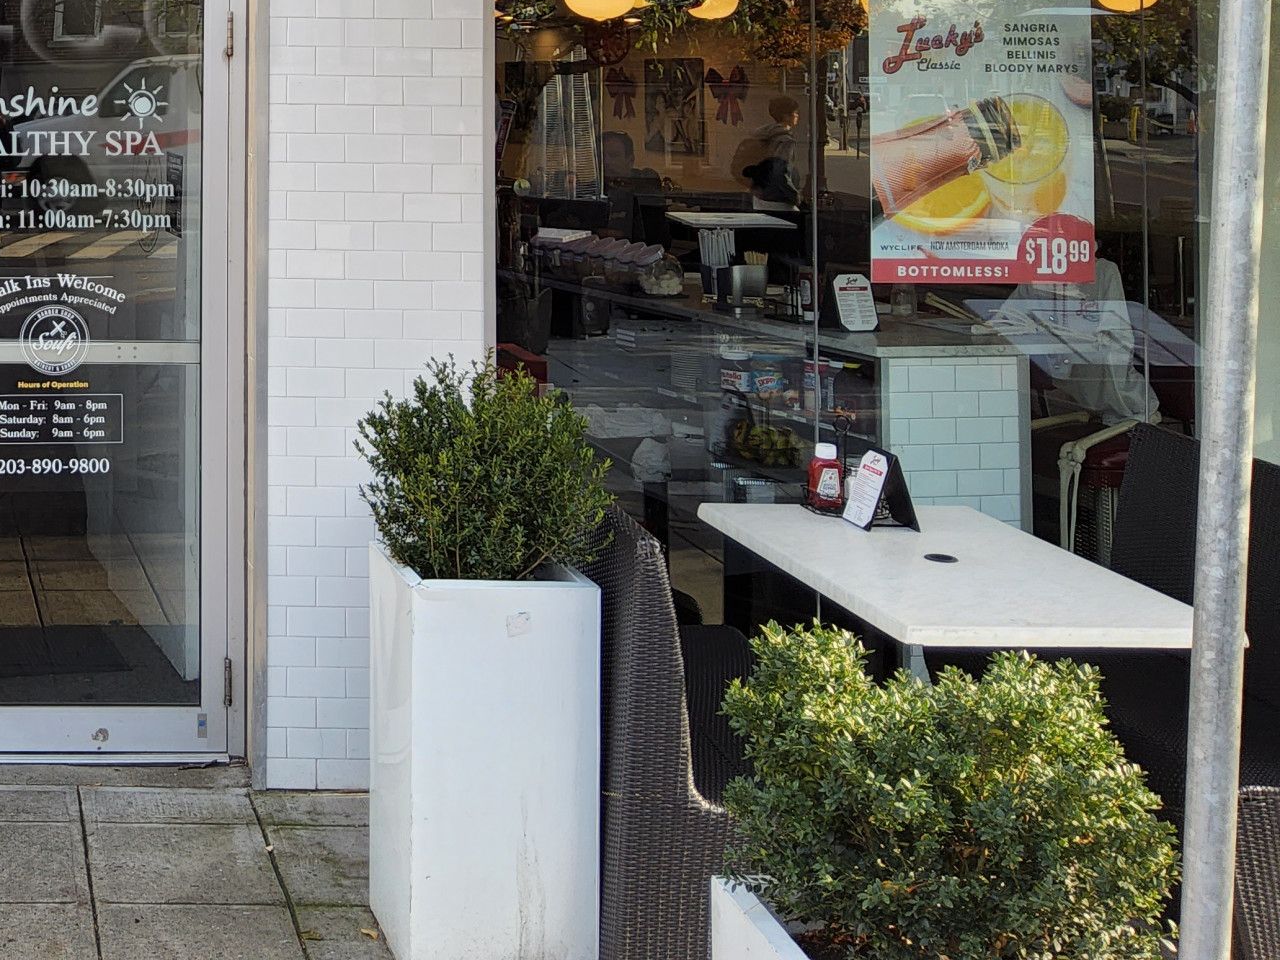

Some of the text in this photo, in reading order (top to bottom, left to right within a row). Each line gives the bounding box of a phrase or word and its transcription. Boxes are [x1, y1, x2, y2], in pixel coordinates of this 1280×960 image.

[1004, 23, 1058, 33] SANGRIA
[882, 14, 985, 75] Lucky's
[1002, 37, 1060, 46] MIMOSAS
[1007, 50, 1057, 60] BELLINIS
[917, 58, 961, 71] Classic
[985, 64, 1079, 73] BLOODY MARYS
[105, 130, 164, 156] SPA
[20, 178, 175, 202] 10:30am-8:30pm
[18, 209, 171, 233] 11:00am-7:30pm
[930, 241, 944, 250] NEW
[945, 242, 986, 251] AMSTERDAM
[988, 241, 1009, 250] VODKA
[897, 266, 1009, 277] BOTTOMLESS!
[24, 275, 51, 290] Ins
[56, 273, 126, 303] Welcome
[61, 292, 117, 315] Appreciated
[33, 332, 77, 355] Soufi
[18, 381, 89, 389] Hours of Operation
[30, 401, 48, 410] Fri:
[54, 401, 76, 410] 9am
[86, 401, 107, 413] 8pm
[0, 415, 105, 427] Saturday: 8am 6pm
[0, 429, 105, 441] Sunday: 9am 6pm
